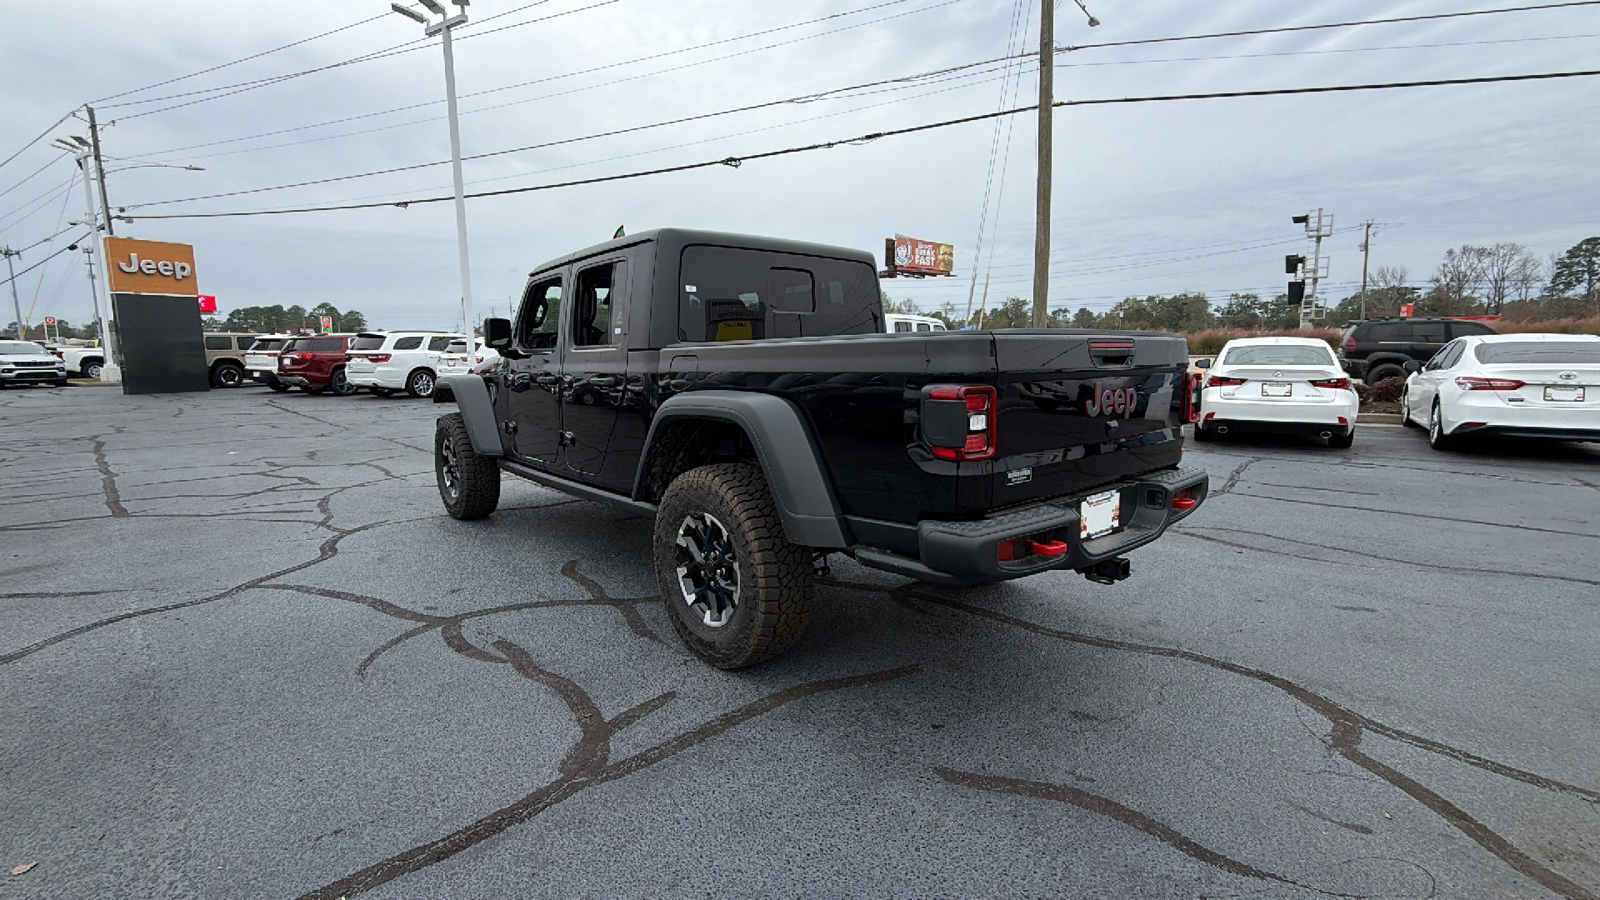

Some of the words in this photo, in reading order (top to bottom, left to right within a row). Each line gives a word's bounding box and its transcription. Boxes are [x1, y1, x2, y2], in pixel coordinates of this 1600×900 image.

[118, 252, 191, 280] Jeep
[915, 255, 935, 266] FAST
[1085, 381, 1137, 420] Jeep
